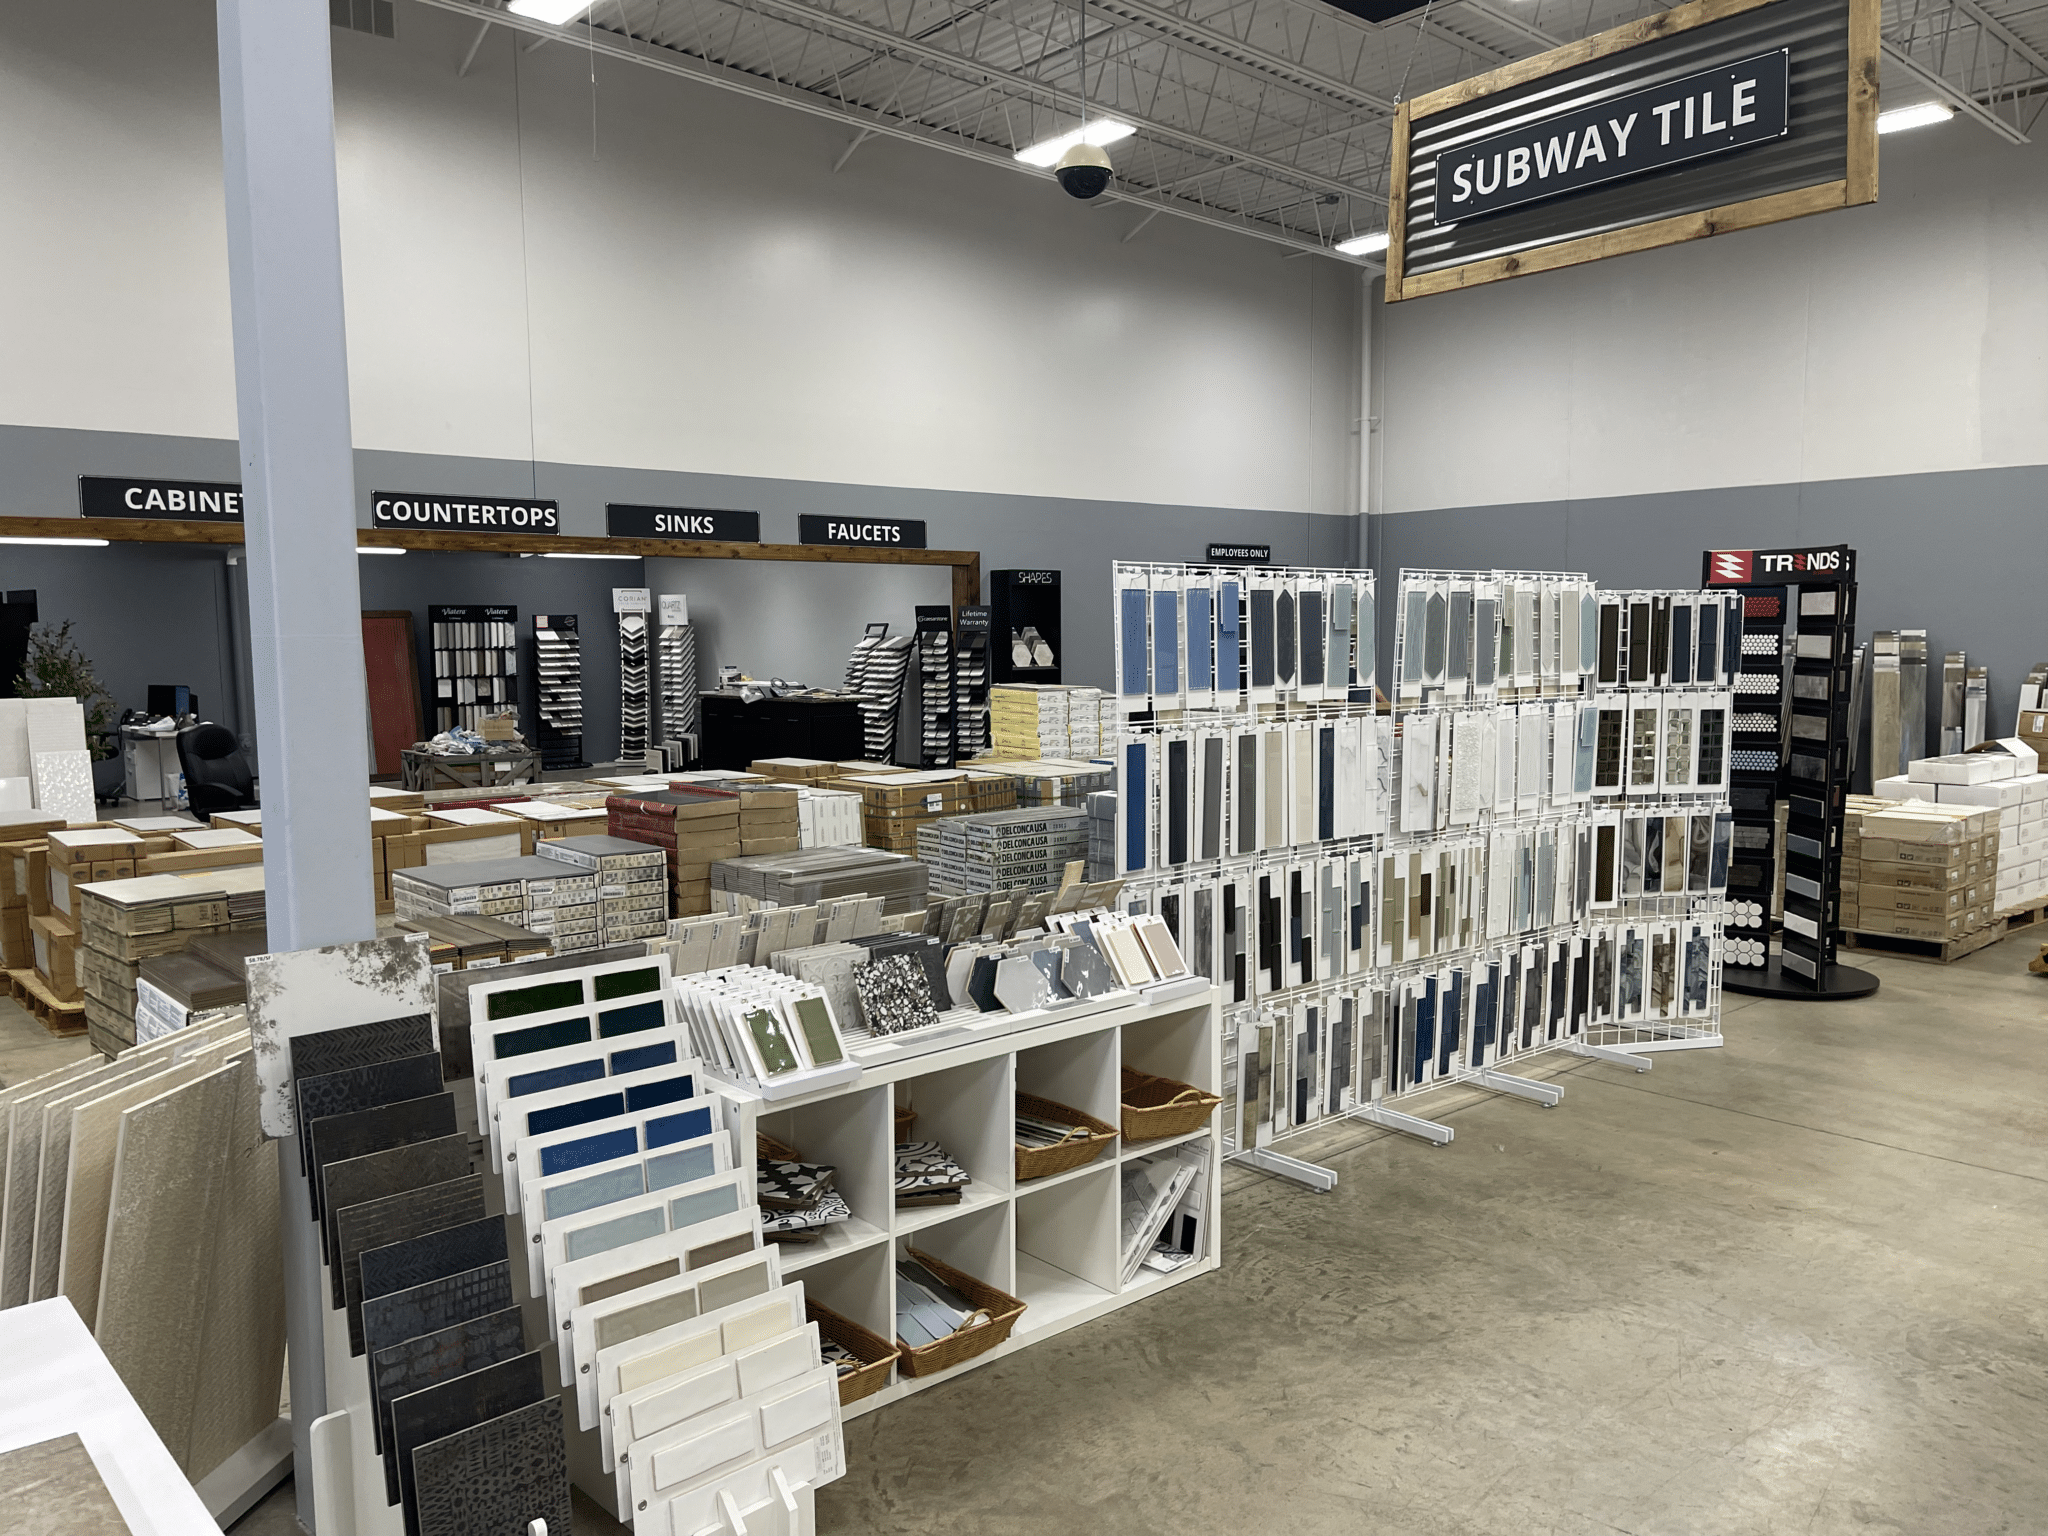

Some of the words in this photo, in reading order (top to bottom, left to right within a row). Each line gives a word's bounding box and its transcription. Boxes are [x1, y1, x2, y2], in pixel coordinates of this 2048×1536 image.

[1451, 112, 1639, 203] SUBWAY
[1652, 78, 1757, 146] TILE
[124, 487, 244, 514] CABINE
[374, 499, 557, 528] COUNTERTOPS
[654, 513, 715, 535] SINKS
[827, 521, 901, 543] FAUCETS
[1211, 547, 1249, 558] EMPLOYEES
[1250, 549, 1269, 558] ONLY
[1018, 571, 1053, 584] SHAPES
[441, 607, 466, 616] Viatera
[484, 607, 508, 616] Viatera
[959, 619, 989, 627] Warranty
